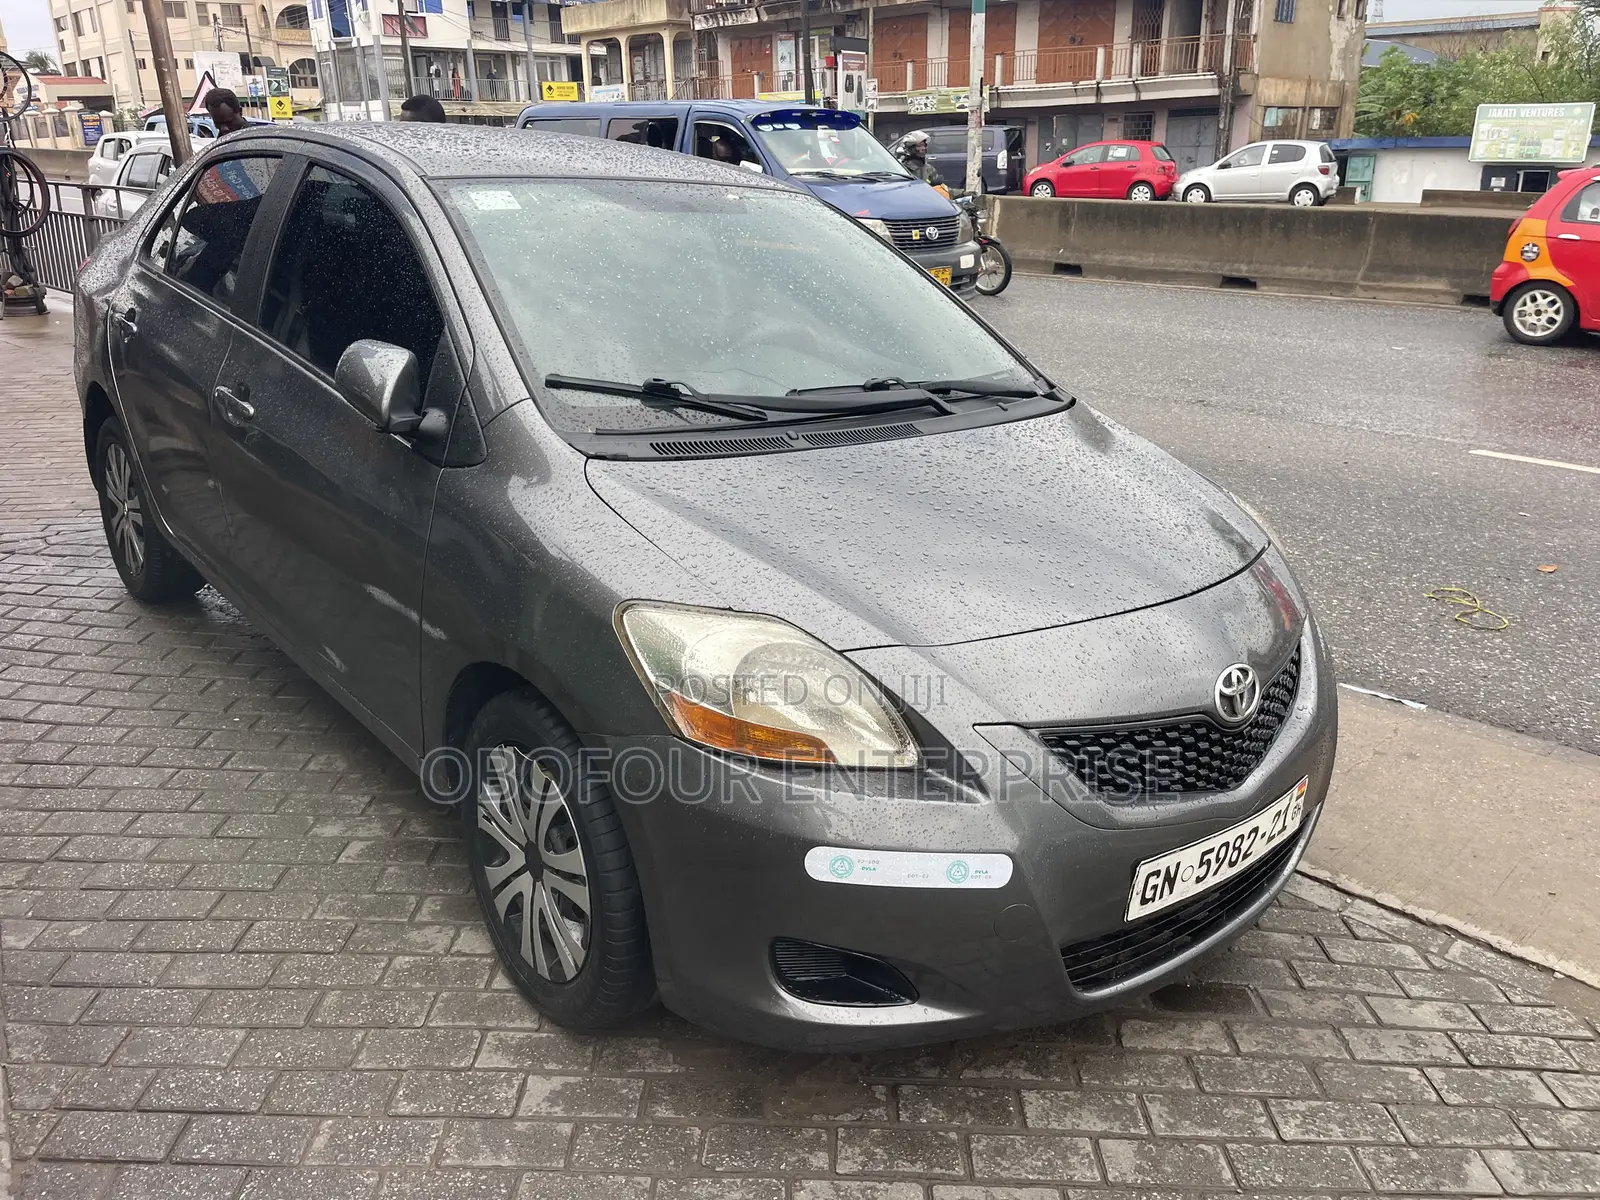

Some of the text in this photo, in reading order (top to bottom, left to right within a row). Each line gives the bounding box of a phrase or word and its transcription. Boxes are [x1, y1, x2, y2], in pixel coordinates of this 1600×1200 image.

[1488, 107, 1566, 118] JAKATI VENTURES
[1139, 794, 1293, 906] GN 5982-21
